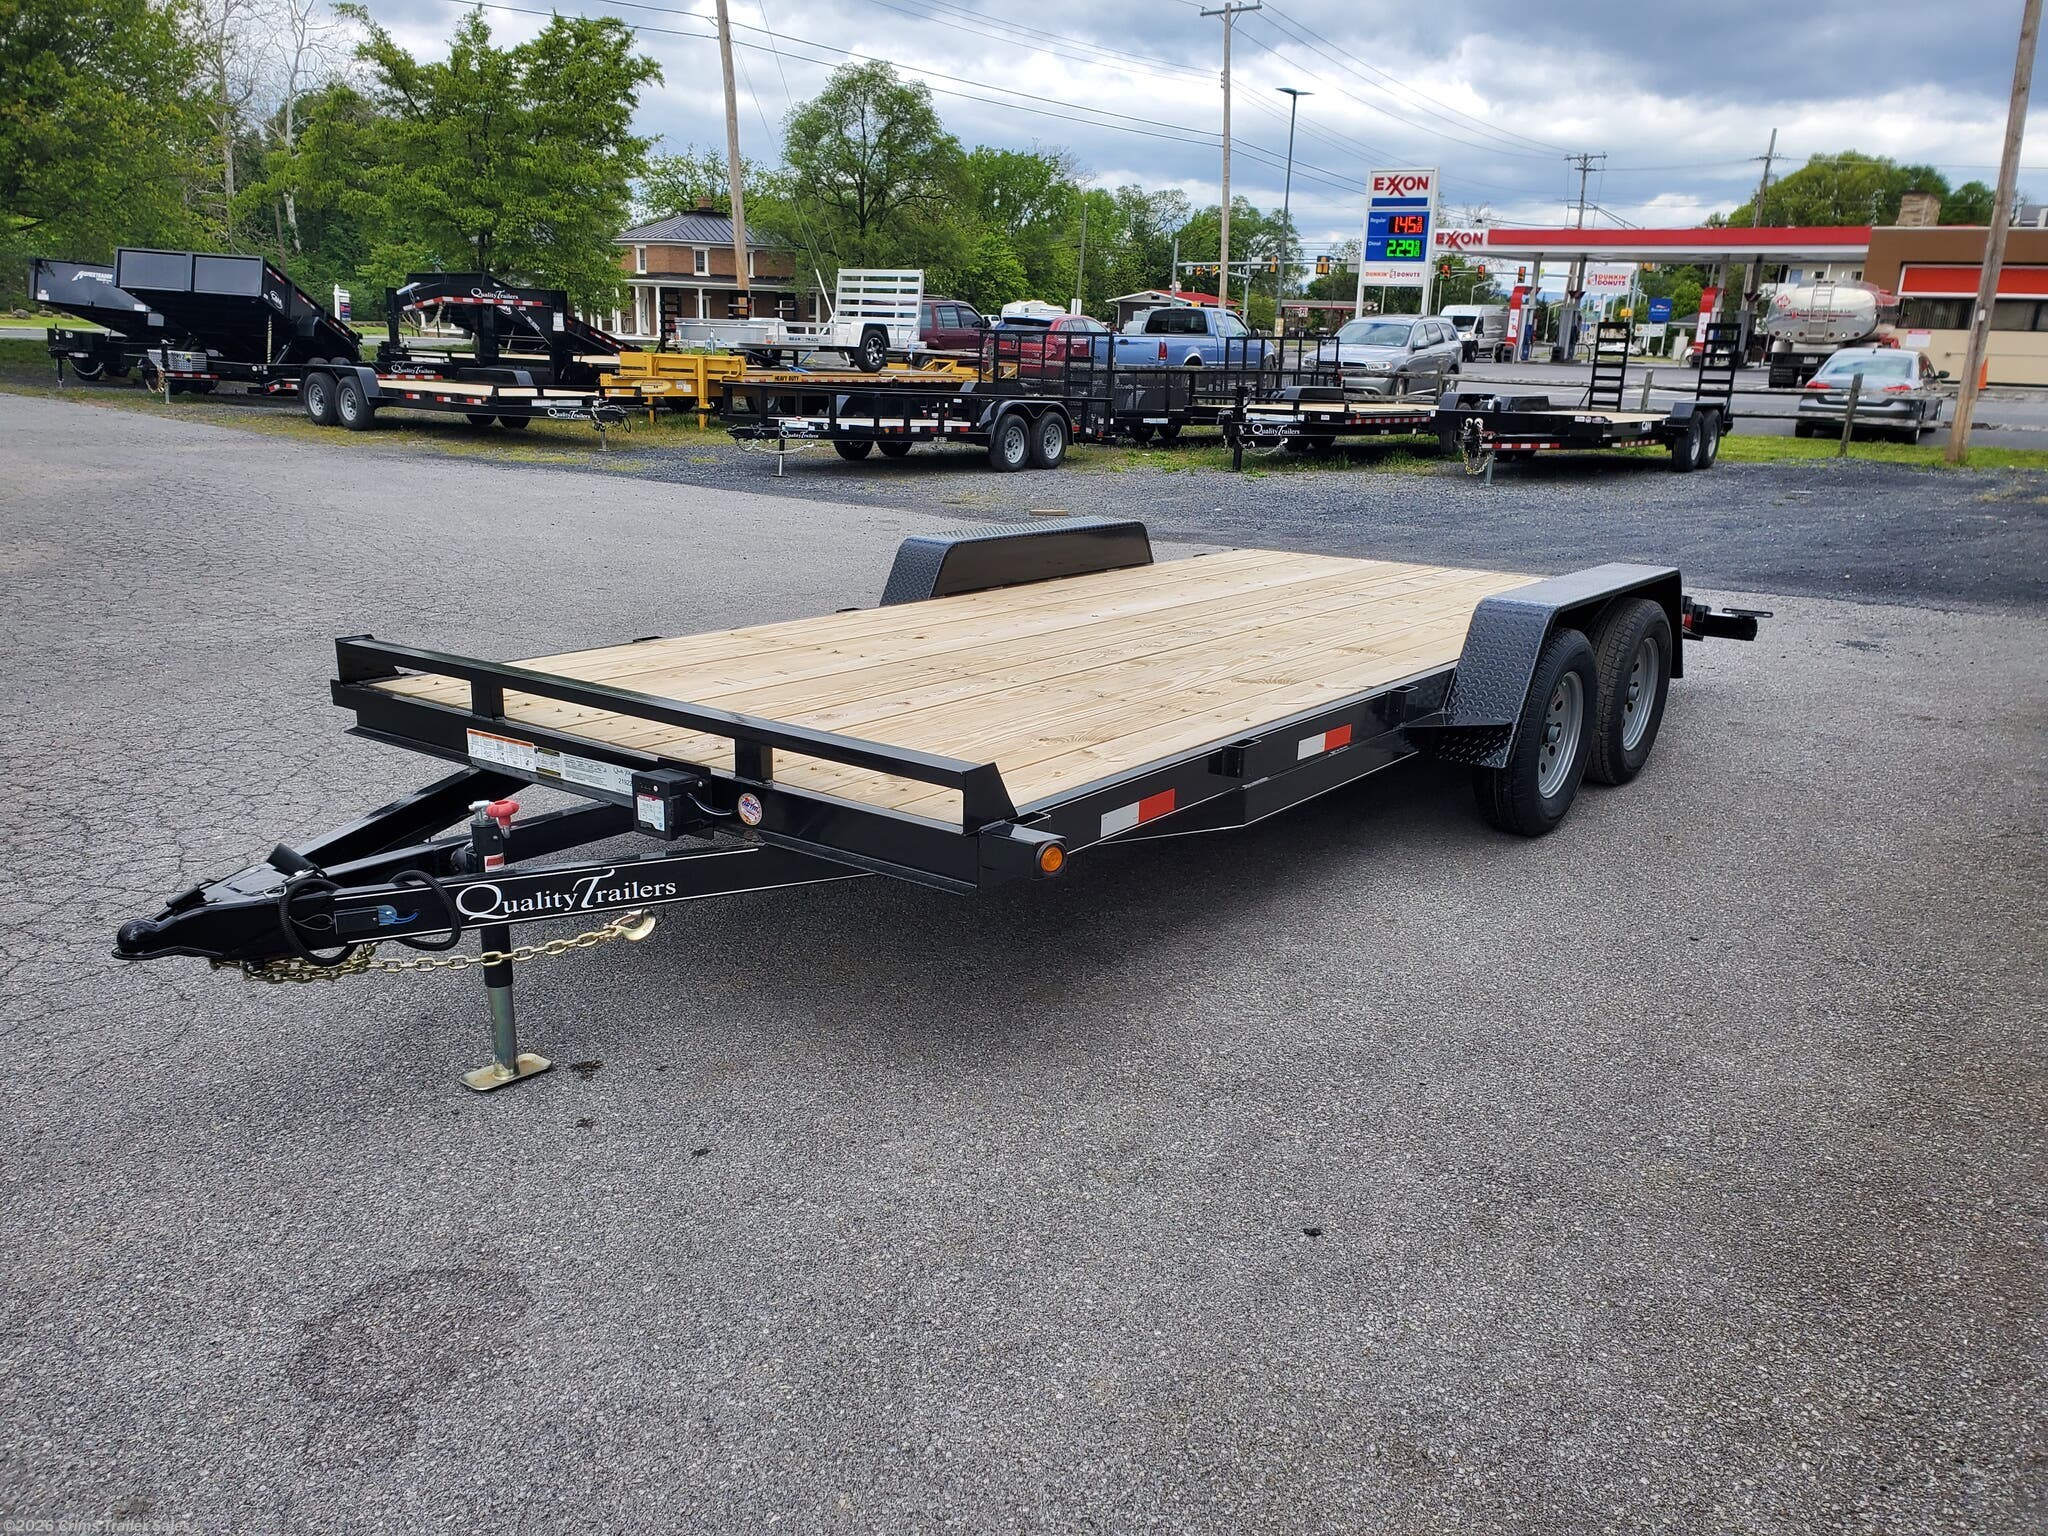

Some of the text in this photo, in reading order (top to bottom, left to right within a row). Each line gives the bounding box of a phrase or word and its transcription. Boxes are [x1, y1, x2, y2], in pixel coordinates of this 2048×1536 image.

[1373, 174, 1429, 197] EXXON
[1435, 230, 1484, 250] EXXON
[470, 288, 519, 300] Quality Trailers
[1251, 423, 1301, 436] Quality Trailers
[455, 868, 678, 921] Quality Trailers
